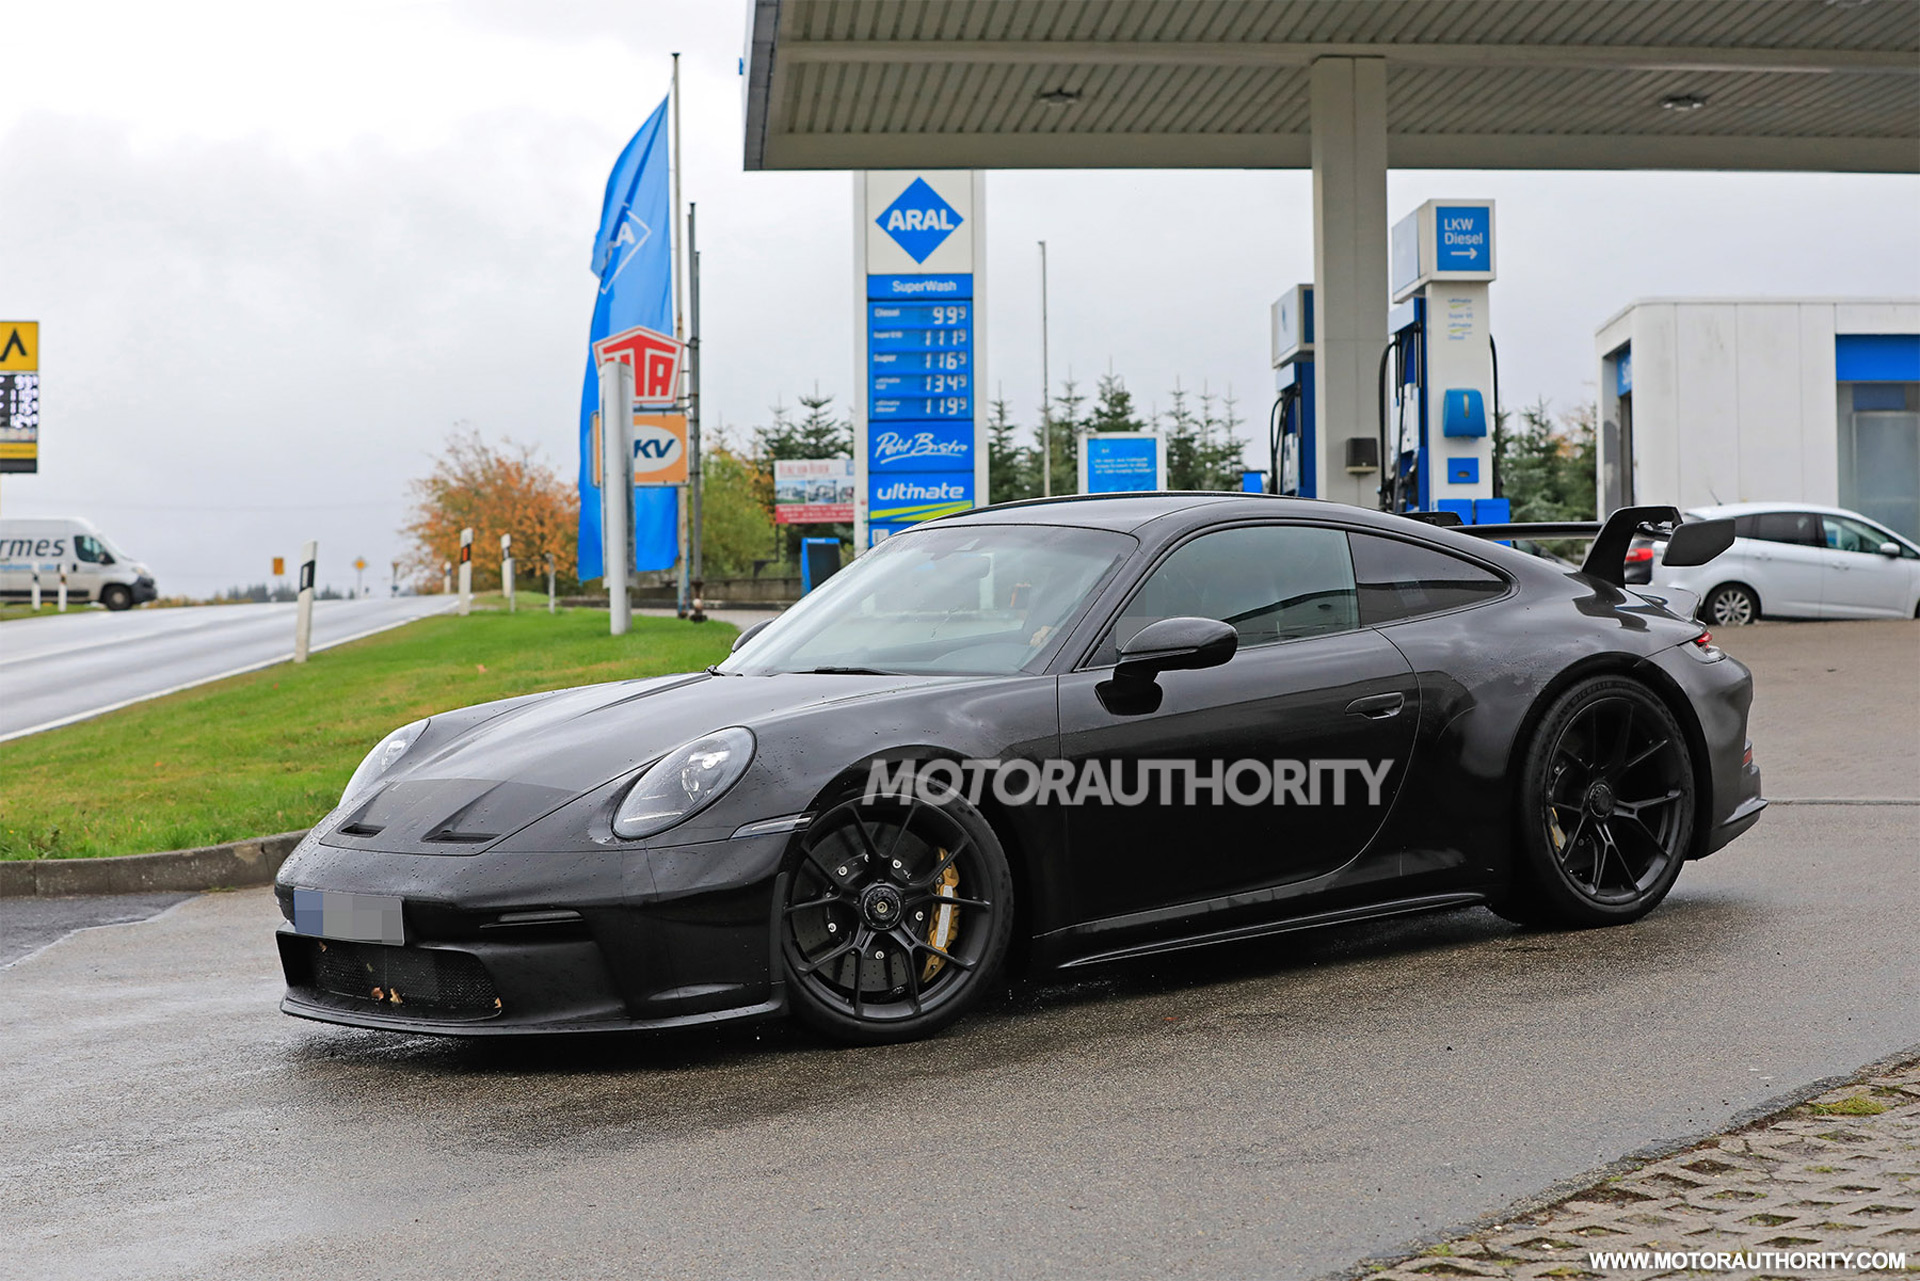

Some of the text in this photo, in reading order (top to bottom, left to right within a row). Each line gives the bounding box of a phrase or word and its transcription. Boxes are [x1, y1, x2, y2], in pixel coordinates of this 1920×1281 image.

[887, 208, 955, 231] ARAL
[1444, 218, 1474, 231] LKW
[1444, 232, 1483, 245] Diesel
[892, 280, 957, 294] SuperWash
[877, 482, 965, 500] ultimate
